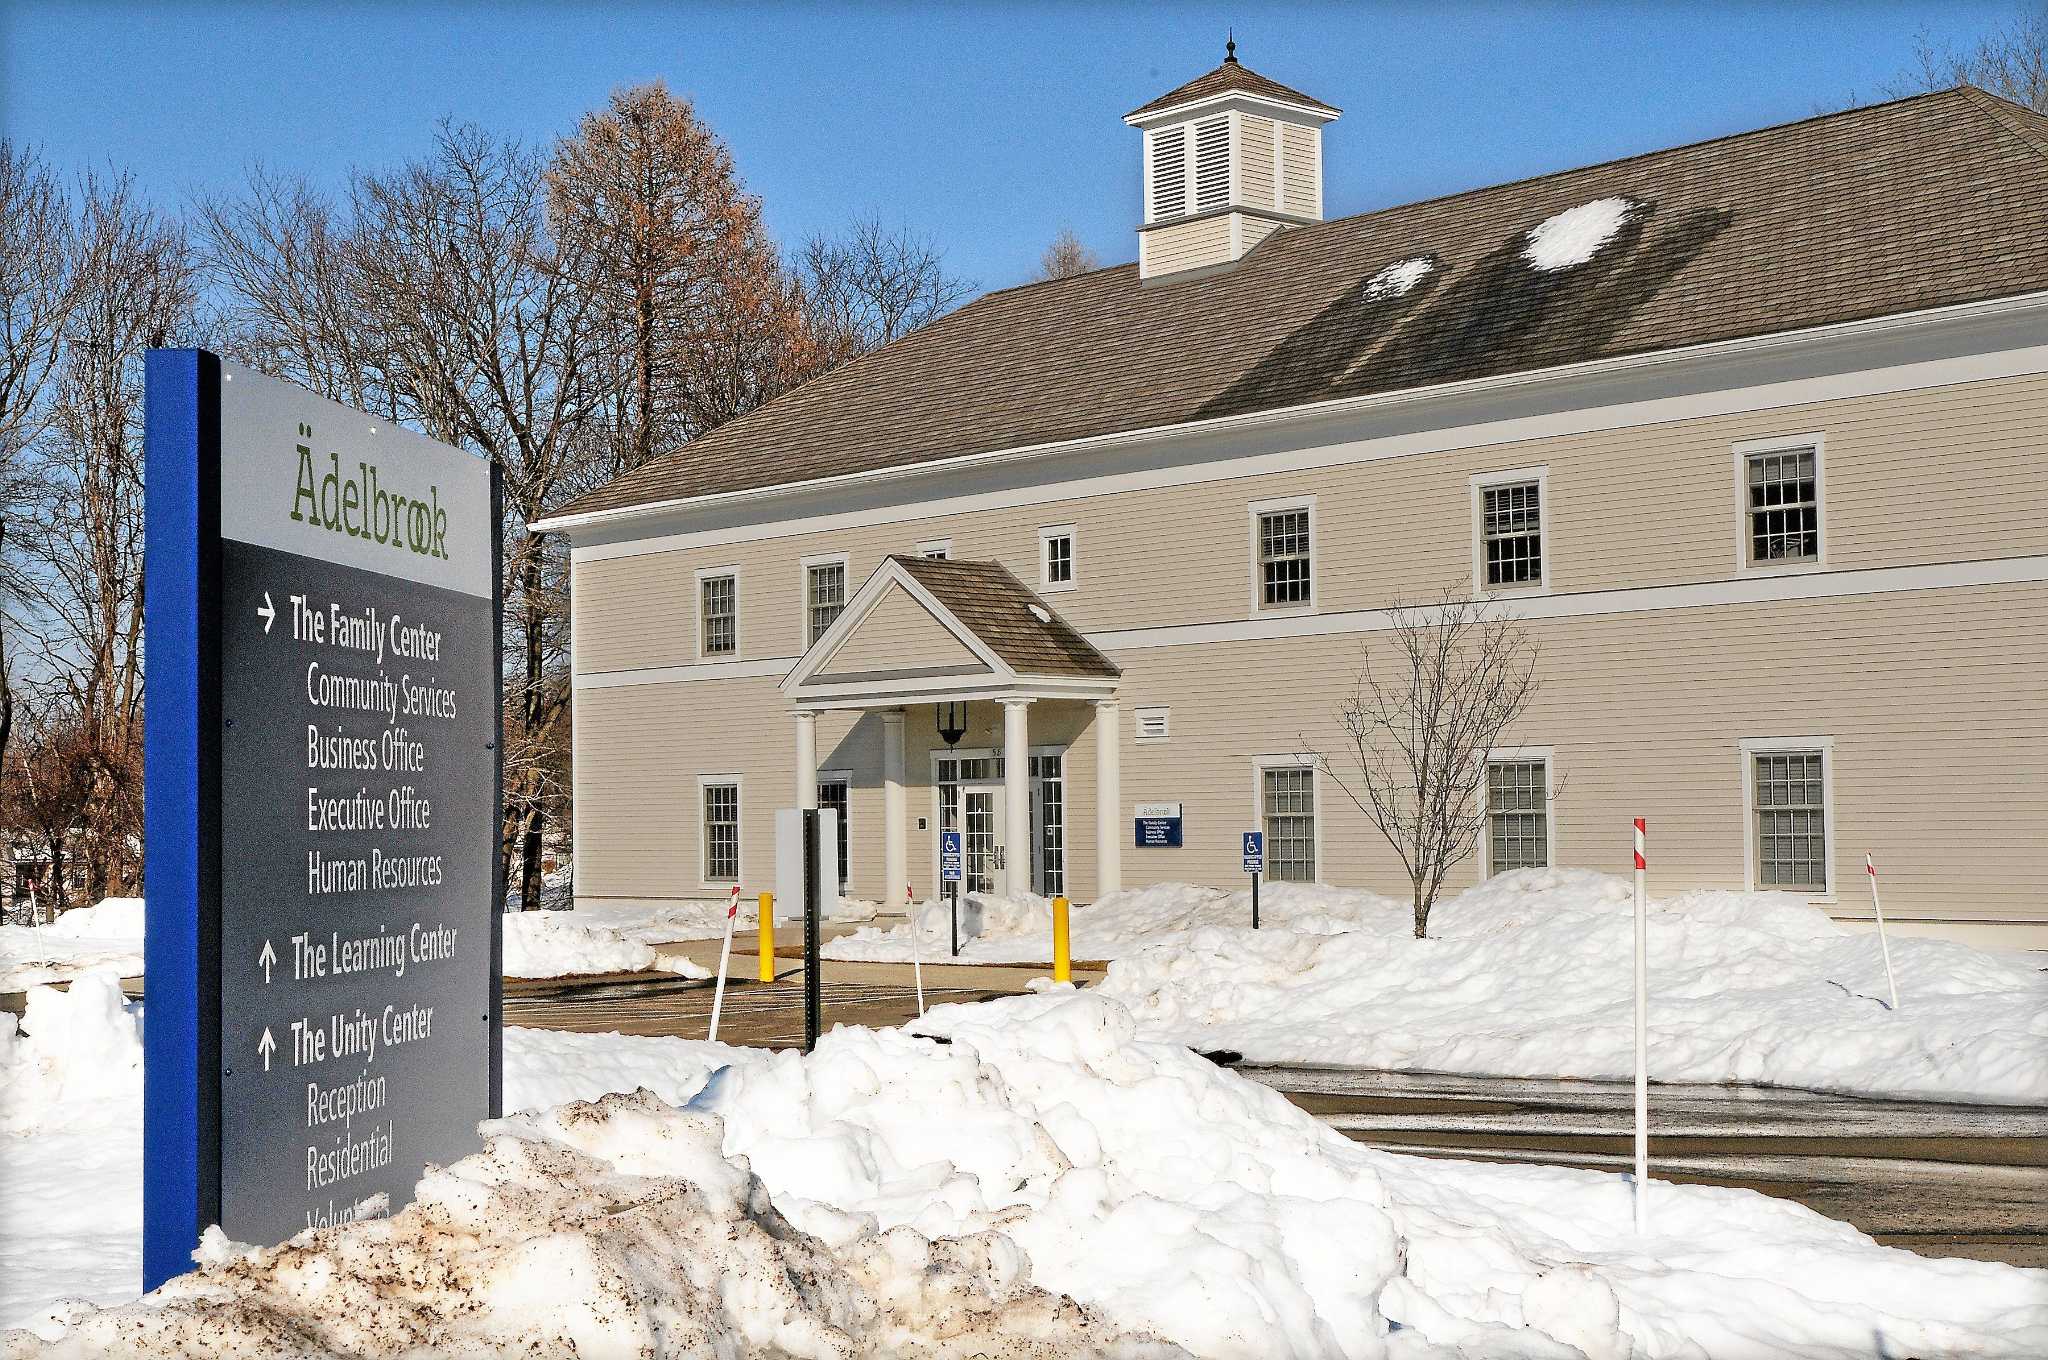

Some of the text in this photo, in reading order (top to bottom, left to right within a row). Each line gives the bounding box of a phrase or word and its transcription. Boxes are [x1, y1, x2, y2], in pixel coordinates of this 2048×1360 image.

[290, 422, 448, 560] Ädelbrook
[290, 595, 441, 664] The Family Center
[308, 662, 456, 724] Community Services
[308, 725, 423, 771] Business Office
[309, 786, 429, 830] Executive Office
[309, 849, 441, 894] Human Resources
[292, 923, 457, 979] The Learning Center
[291, 1003, 432, 1066] The Unity Center
[308, 1069, 385, 1129] Reception
[308, 1119, 392, 1190] Residential
